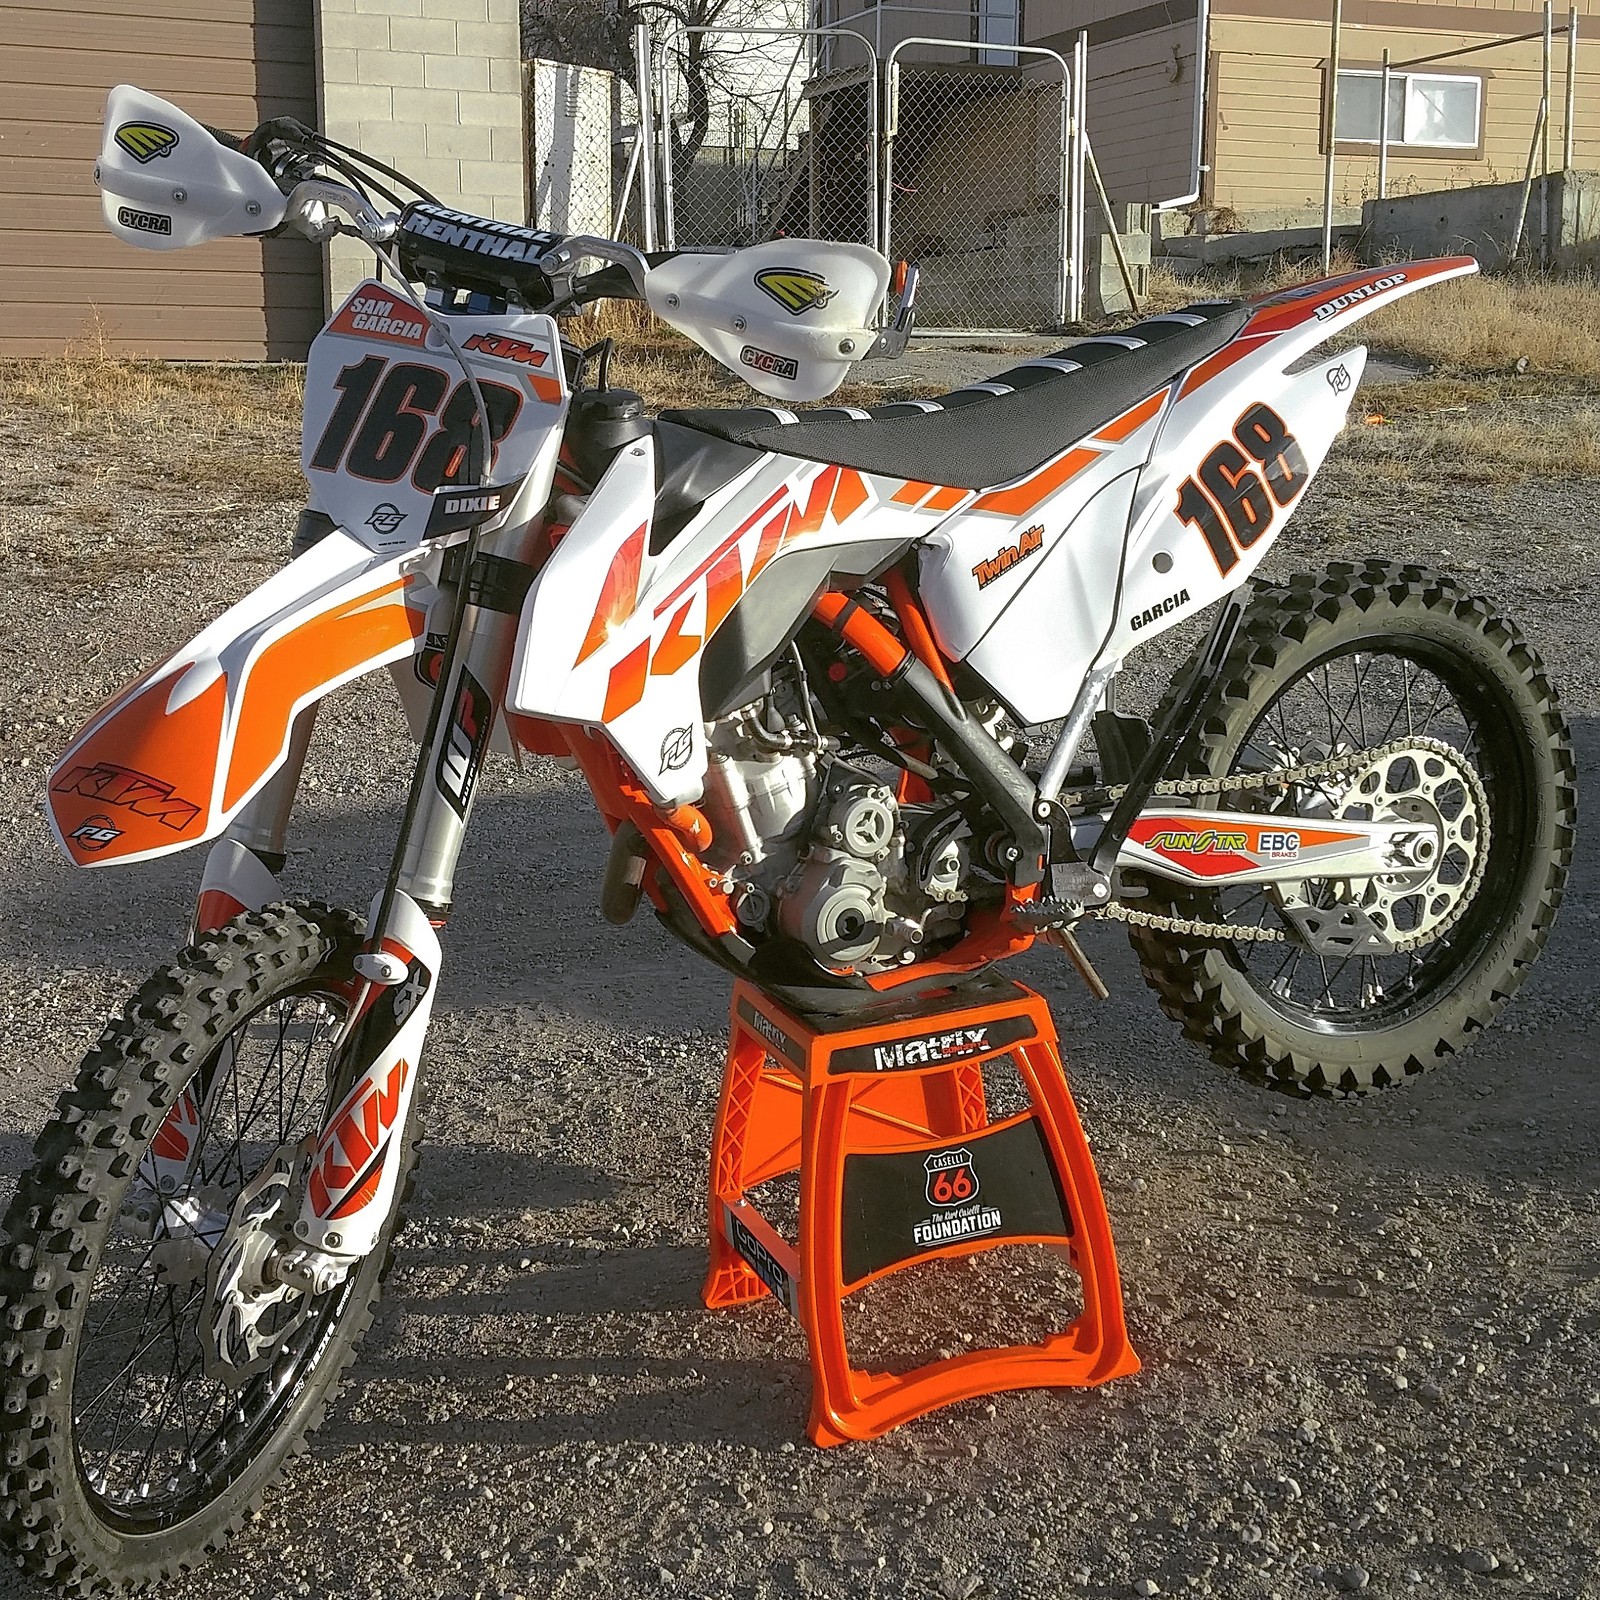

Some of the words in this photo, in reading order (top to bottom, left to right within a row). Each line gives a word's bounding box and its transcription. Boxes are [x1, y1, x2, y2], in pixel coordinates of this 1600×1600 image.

[119, 209, 170, 233] CYCRA
[402, 211, 546, 265] RENTHAL
[415, 203, 552, 243] RENTHAL
[350, 297, 394, 318] SAM
[1313, 272, 1407, 321] DUNLOP
[352, 315, 424, 340] GARCIA
[462, 333, 550, 368] KTM
[742, 348, 796, 378] CYCRA
[309, 353, 525, 496] 168
[444, 494, 501, 515] DIXIE
[1173, 401, 1310, 580] 168
[972, 545, 1018, 588] Twin
[1018, 523, 1045, 558] Air
[1130, 588, 1192, 632] GARCIA
[52, 761, 203, 832] KTM
[1259, 833, 1300, 851] EBC
[874, 1027, 992, 1071] Matrix
[933, 1154, 964, 1169] CASELLI
[933, 1168, 972, 1203] 66
[913, 1210, 1002, 1244] FOUNDATION
[932, 1213, 943, 1224] The
[735, 1219, 784, 1286] GoPro
